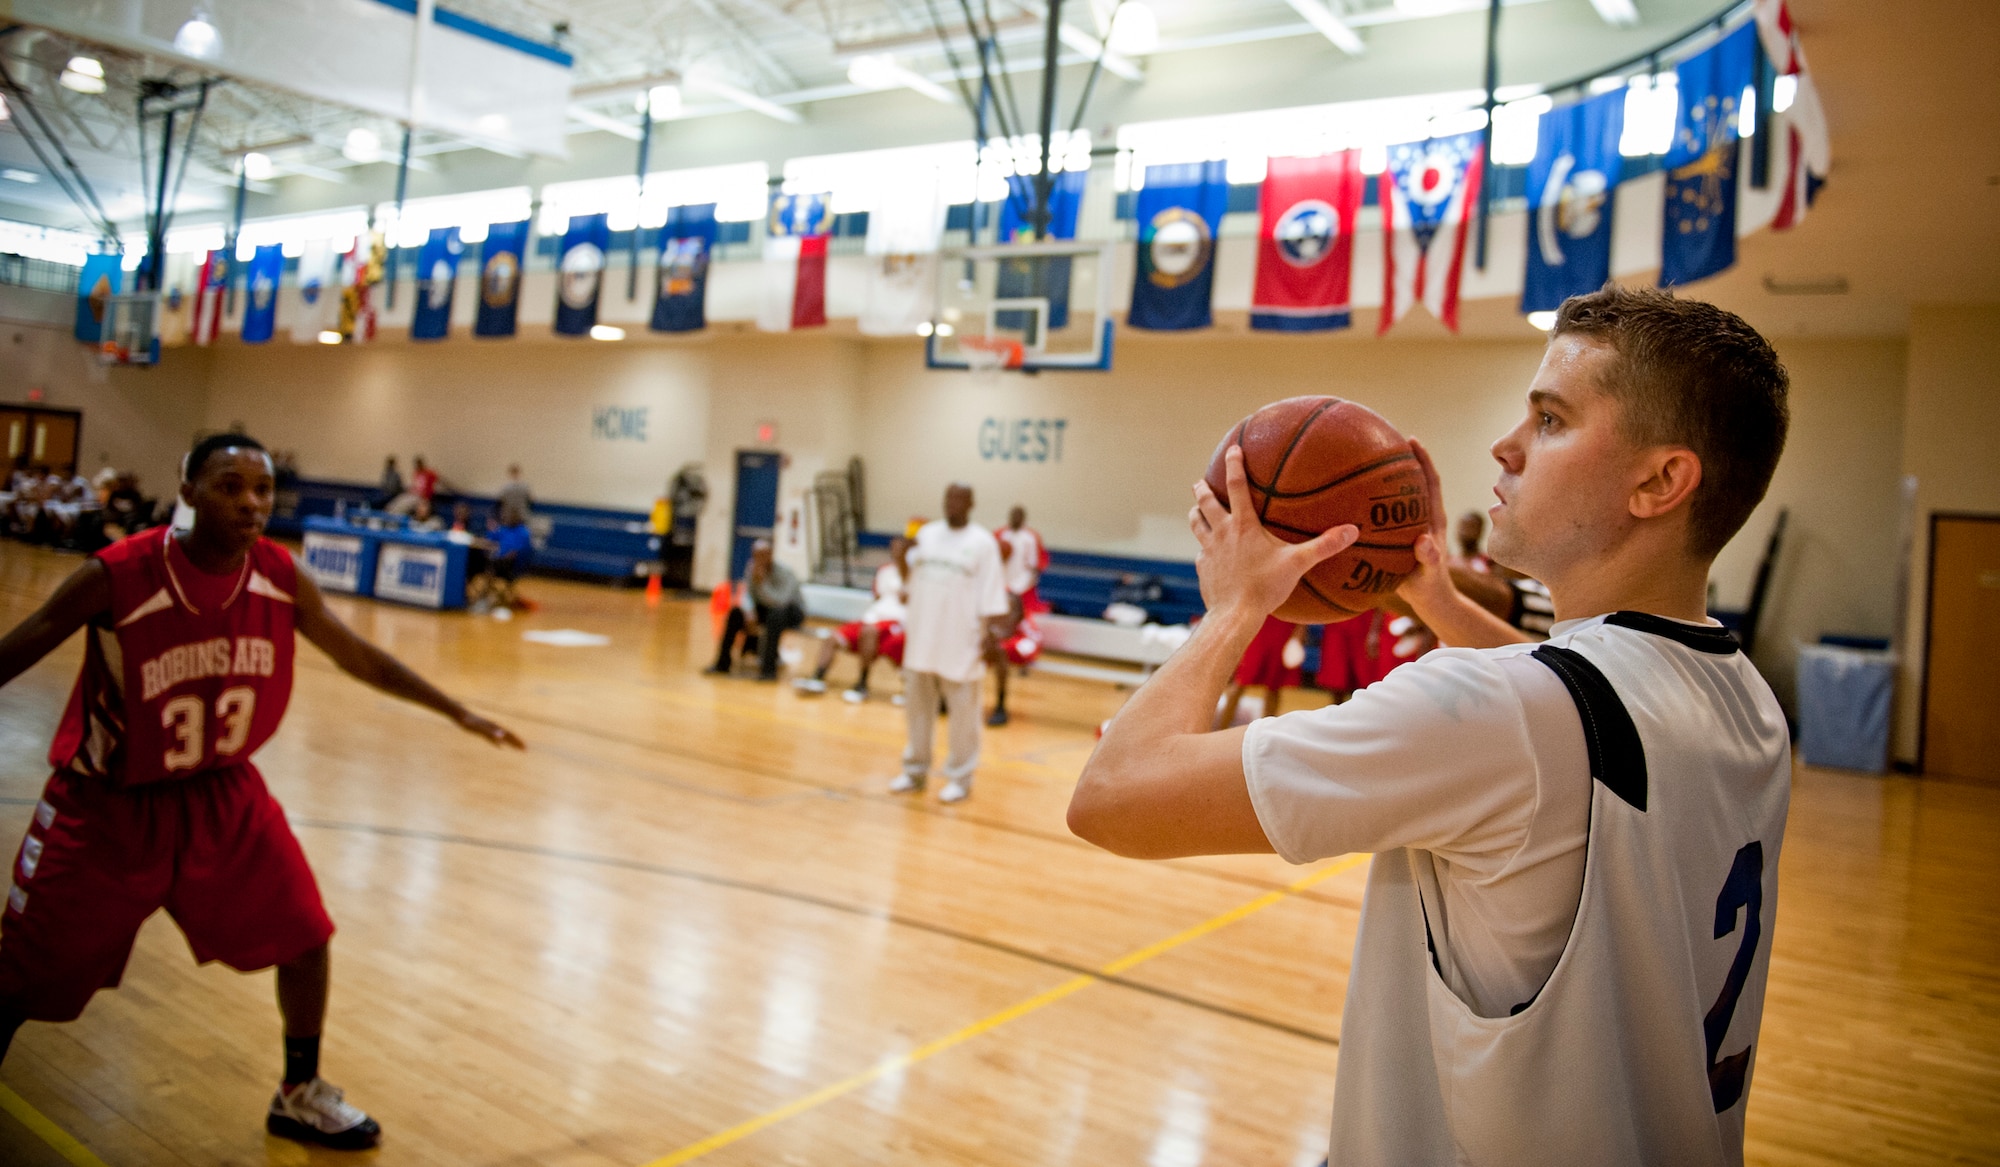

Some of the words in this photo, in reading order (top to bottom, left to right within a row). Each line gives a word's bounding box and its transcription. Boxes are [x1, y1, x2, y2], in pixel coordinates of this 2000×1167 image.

[591, 405, 649, 442] HOME
[978, 417, 1067, 462] GUEST
[141, 636, 231, 702] ROBINS
[231, 636, 275, 678] AFB
[161, 685, 257, 772] 33
[1703, 840, 1763, 1115] 2
